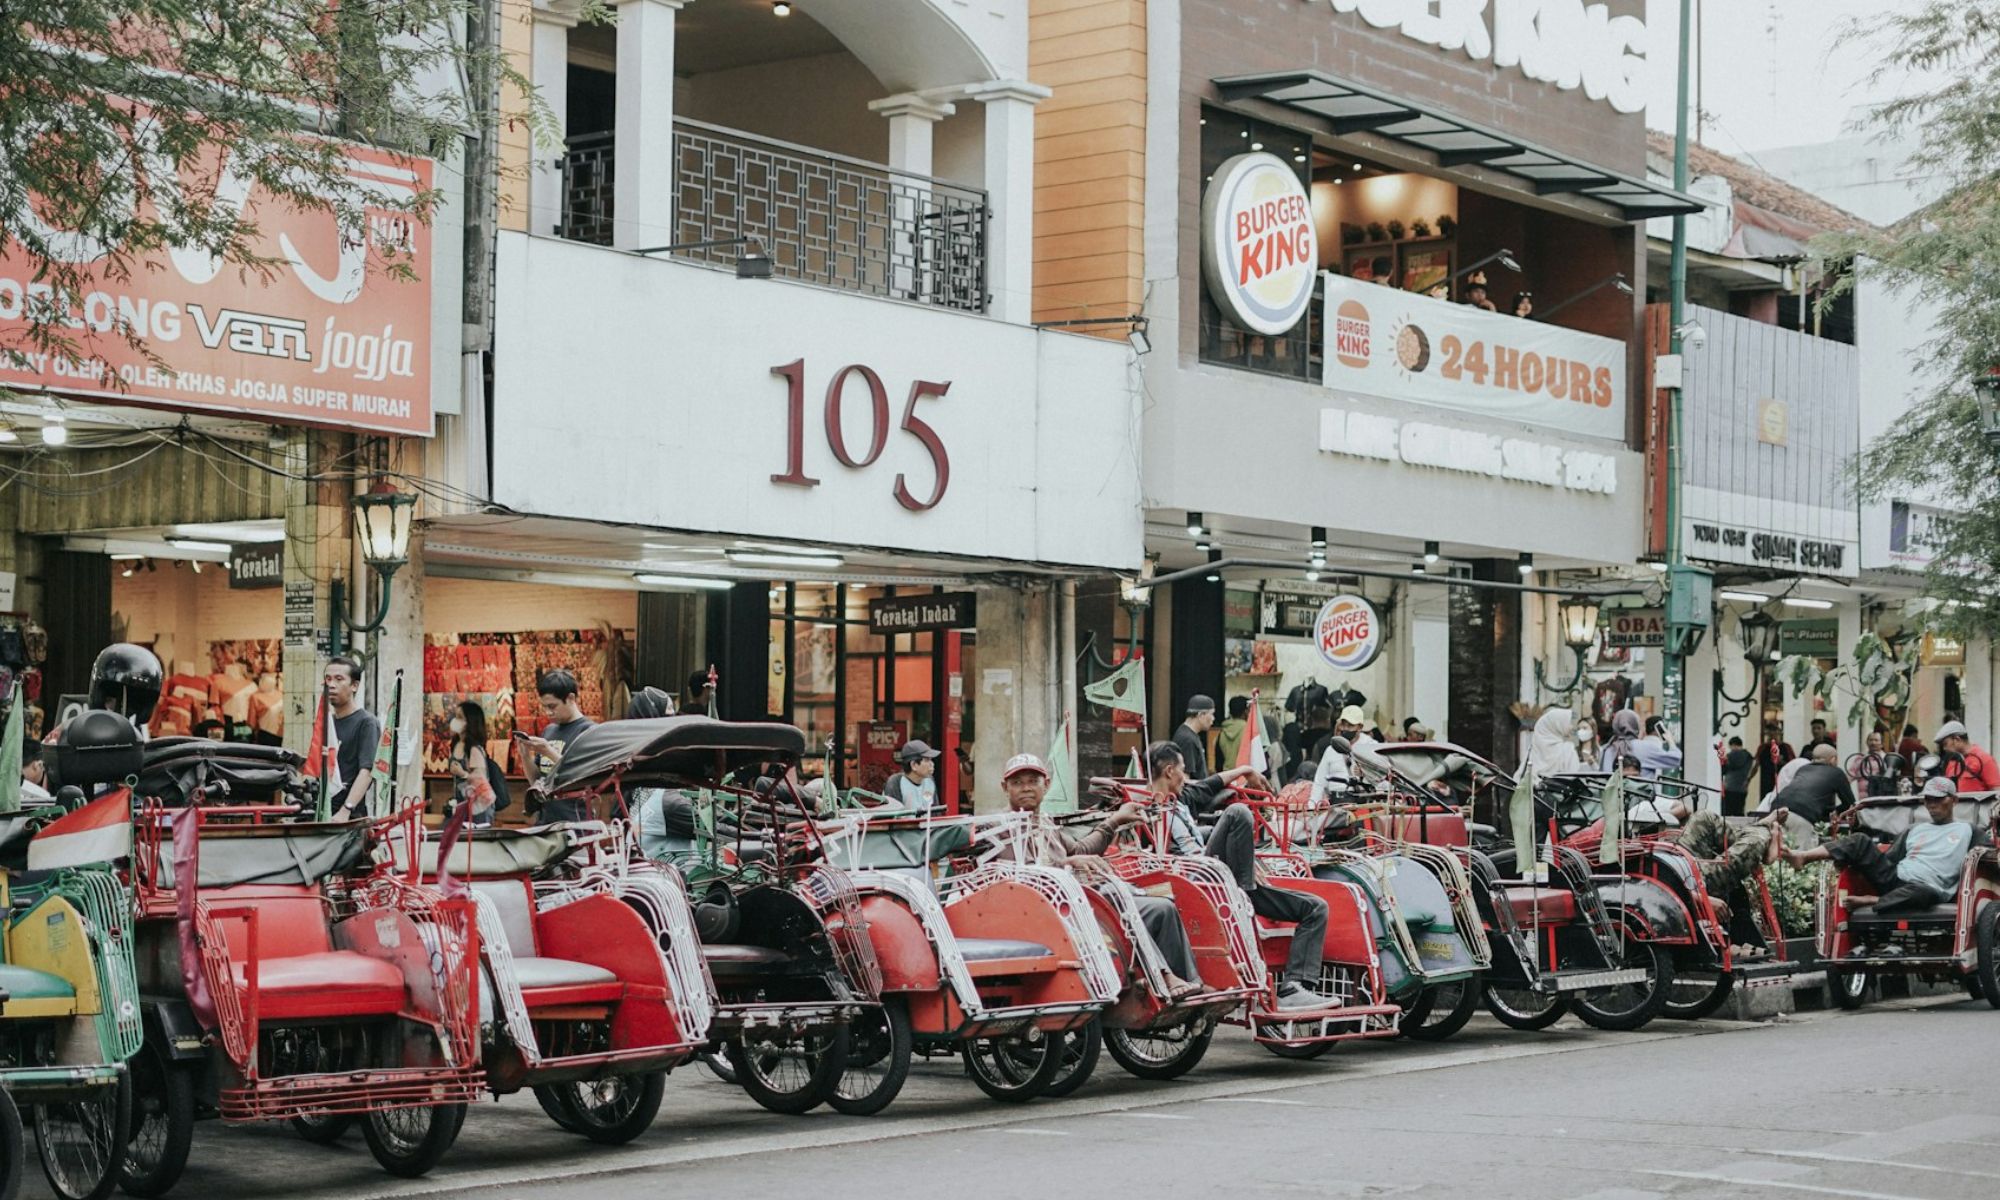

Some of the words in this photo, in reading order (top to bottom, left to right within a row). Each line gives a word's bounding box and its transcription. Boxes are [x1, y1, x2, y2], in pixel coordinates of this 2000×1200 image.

[1237, 195, 1306, 242] BURGER
[1240, 223, 1310, 286] KING
[186, 303, 312, 362] Van
[1337, 318, 1370, 337] BURGER
[1337, 333, 1370, 357] KING
[120, 363, 170, 388] OLEH
[175, 370, 226, 396] KHAS
[230, 378, 288, 403] JOGJA
[293, 387, 348, 411] SUPER
[353, 393, 411, 419] MURAH
[1441, 334, 1488, 385] 24
[1493, 345, 1613, 408] HOURS
[770, 357, 952, 511] 105
[1321, 610, 1368, 634] BURGER
[1323, 622, 1369, 652] KING
[867, 731, 900, 745] SPICY
